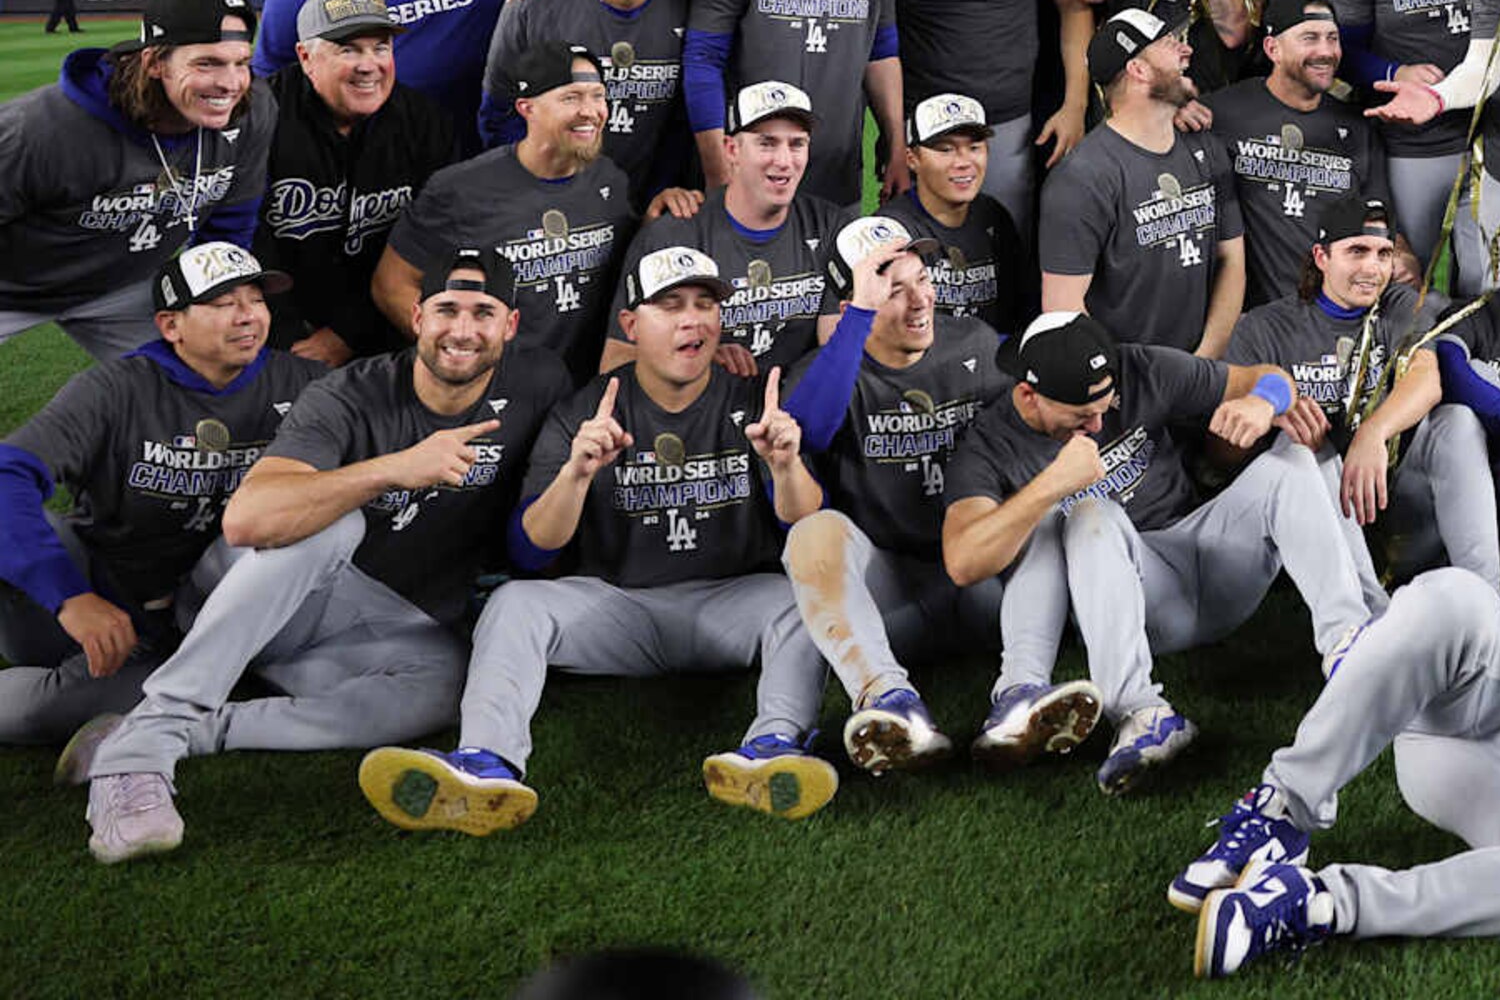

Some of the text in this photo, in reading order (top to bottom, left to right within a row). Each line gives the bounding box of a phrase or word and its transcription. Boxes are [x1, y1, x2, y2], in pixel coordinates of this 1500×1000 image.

[805, 18, 827, 53] LA
[1446, 3, 1470, 34] LA
[630, 64, 680, 81] SERIE
[608, 100, 634, 133] LA
[1235, 154, 1351, 190] CHAMPIONS
[1236, 141, 1352, 171] WORLD SERIES
[1132, 199, 1182, 225] WORLD
[1282, 182, 1305, 217] LA
[1135, 206, 1216, 245] CHAMPION
[496, 225, 614, 264] WORLD SERIES
[1177, 233, 1201, 267] LA
[554, 275, 581, 312] LA
[769, 274, 826, 300] SERIES
[867, 412, 936, 435] WORLD
[143, 440, 223, 471] WORLD
[614, 453, 749, 486] WORLD SERIES
[920, 454, 945, 497] LA
[612, 474, 750, 512] CHAMPIONS
[666, 508, 697, 551] LA
